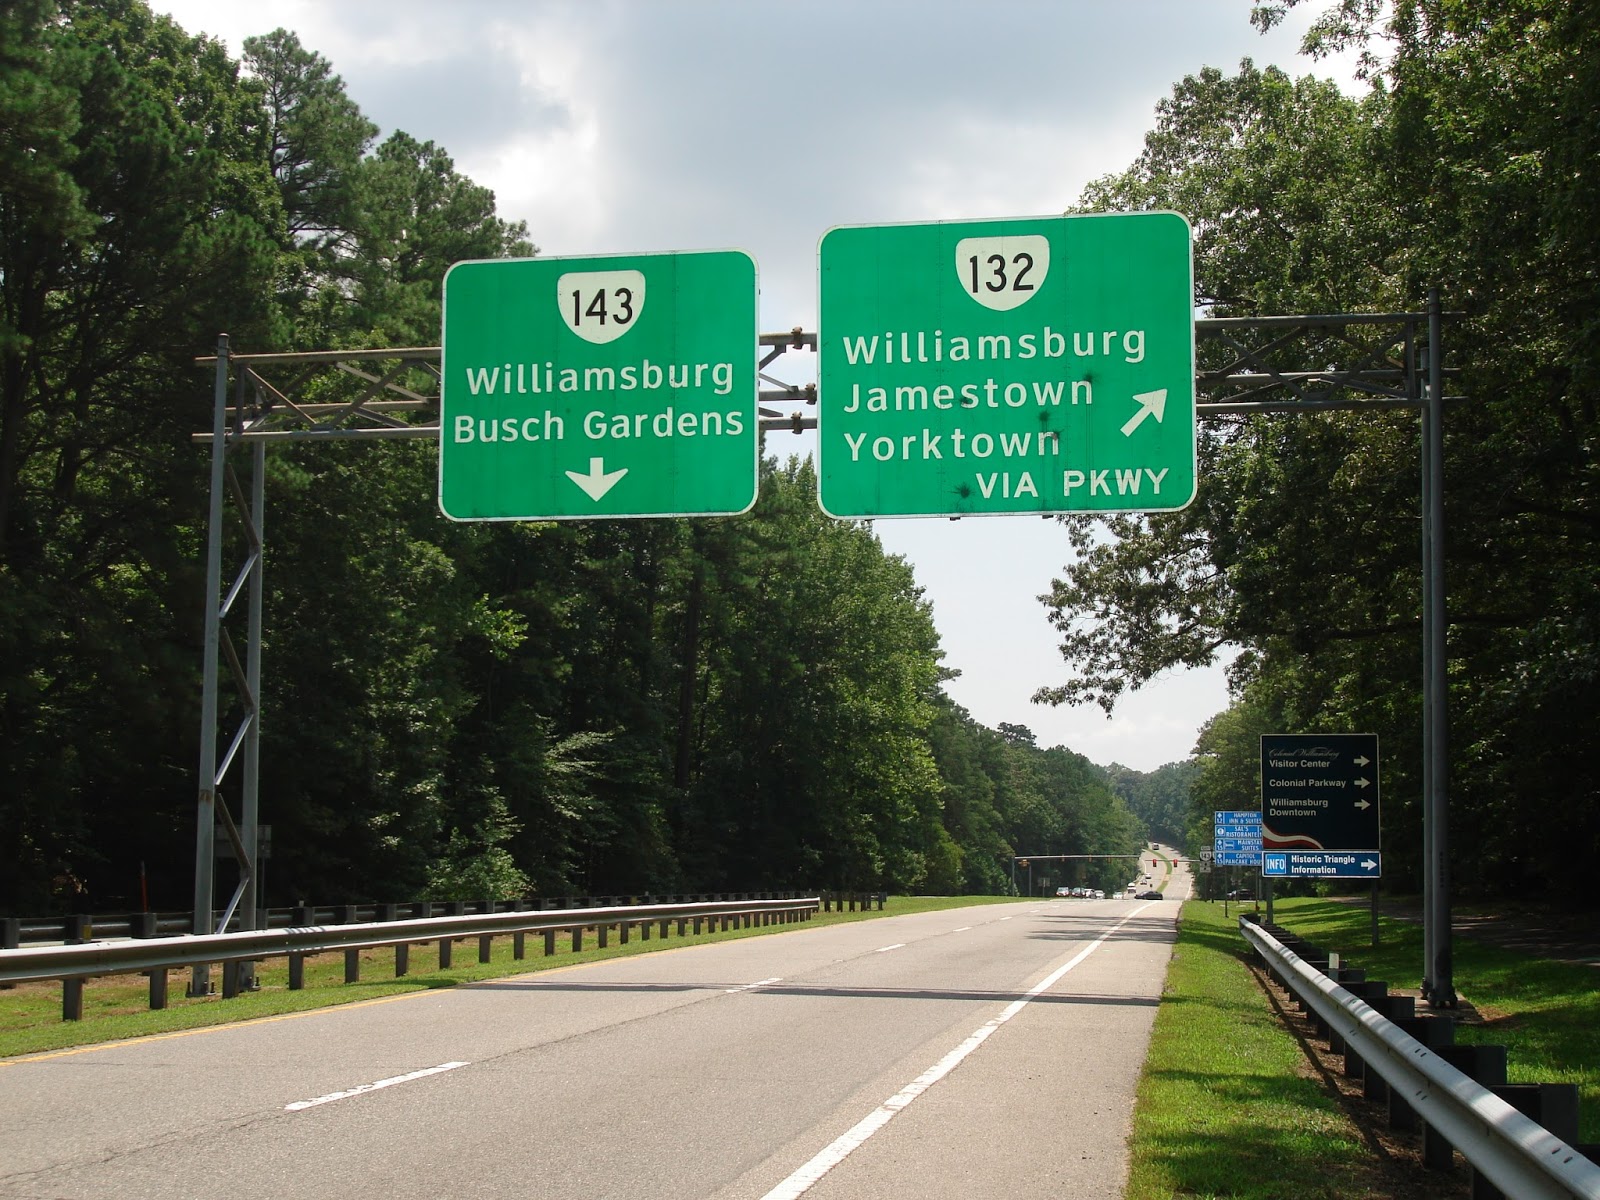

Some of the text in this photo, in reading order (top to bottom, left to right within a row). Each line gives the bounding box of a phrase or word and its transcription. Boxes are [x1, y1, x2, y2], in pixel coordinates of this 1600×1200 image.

[969, 252, 1034, 294] 132
[572, 287, 633, 327] 143
[844, 326, 1145, 365] Williamsburg
[466, 358, 733, 396] Williamsburg
[843, 378, 1092, 413] Jamestown
[454, 406, 744, 443] Busch Gardens
[843, 428, 1059, 462] Yorktown
[975, 467, 1169, 499] VIA PKWY
[1268, 747, 1341, 760] Colonial Williamsburg
[1269, 759, 1331, 768] Visitor Center
[1269, 778, 1347, 789] Colonial Parkway
[1269, 798, 1329, 808] Williamsburg
[1269, 808, 1317, 817] Downtown
[1266, 858, 1285, 871] INFO
[1291, 855, 1356, 864] Historic Triangle
[1291, 865, 1337, 874] Information
